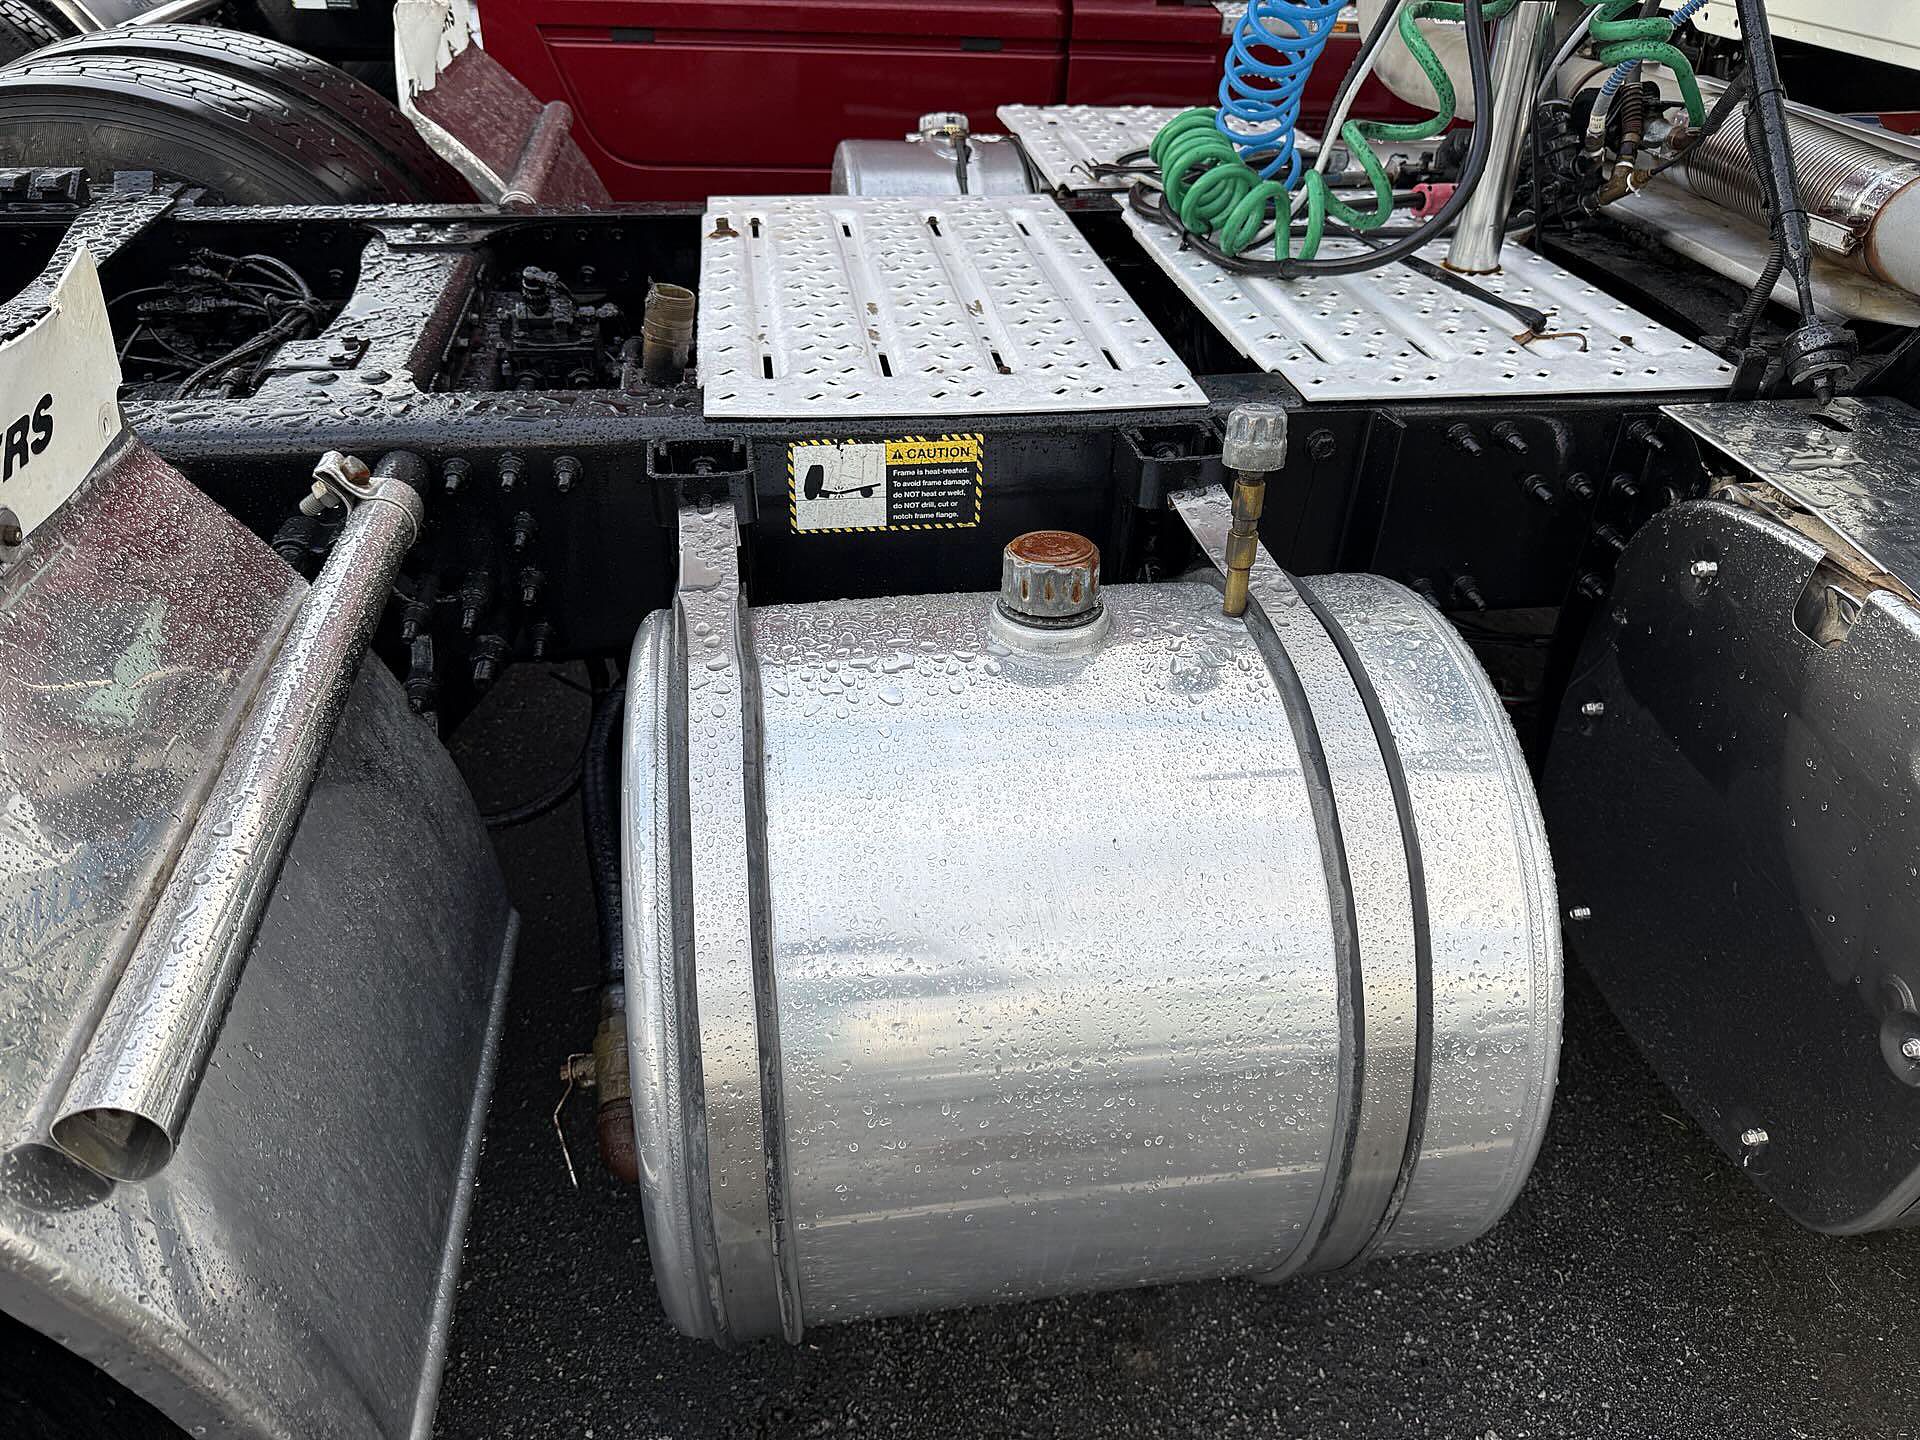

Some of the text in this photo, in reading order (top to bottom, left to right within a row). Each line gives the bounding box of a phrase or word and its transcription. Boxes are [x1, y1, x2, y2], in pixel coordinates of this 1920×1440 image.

[0, 393, 53, 483] RS
[907, 447, 970, 459] CAUTION
[925, 467, 969, 475] heat-treated.
[902, 479, 921, 487] avoid
[943, 478, 971, 486] damage,
[893, 491, 903, 499] do
[921, 490, 938, 498] heat
[947, 489, 966, 498] weld,
[893, 502, 903, 510] do
[921, 501, 937, 509] drill,
[935, 511, 959, 519] flange.
